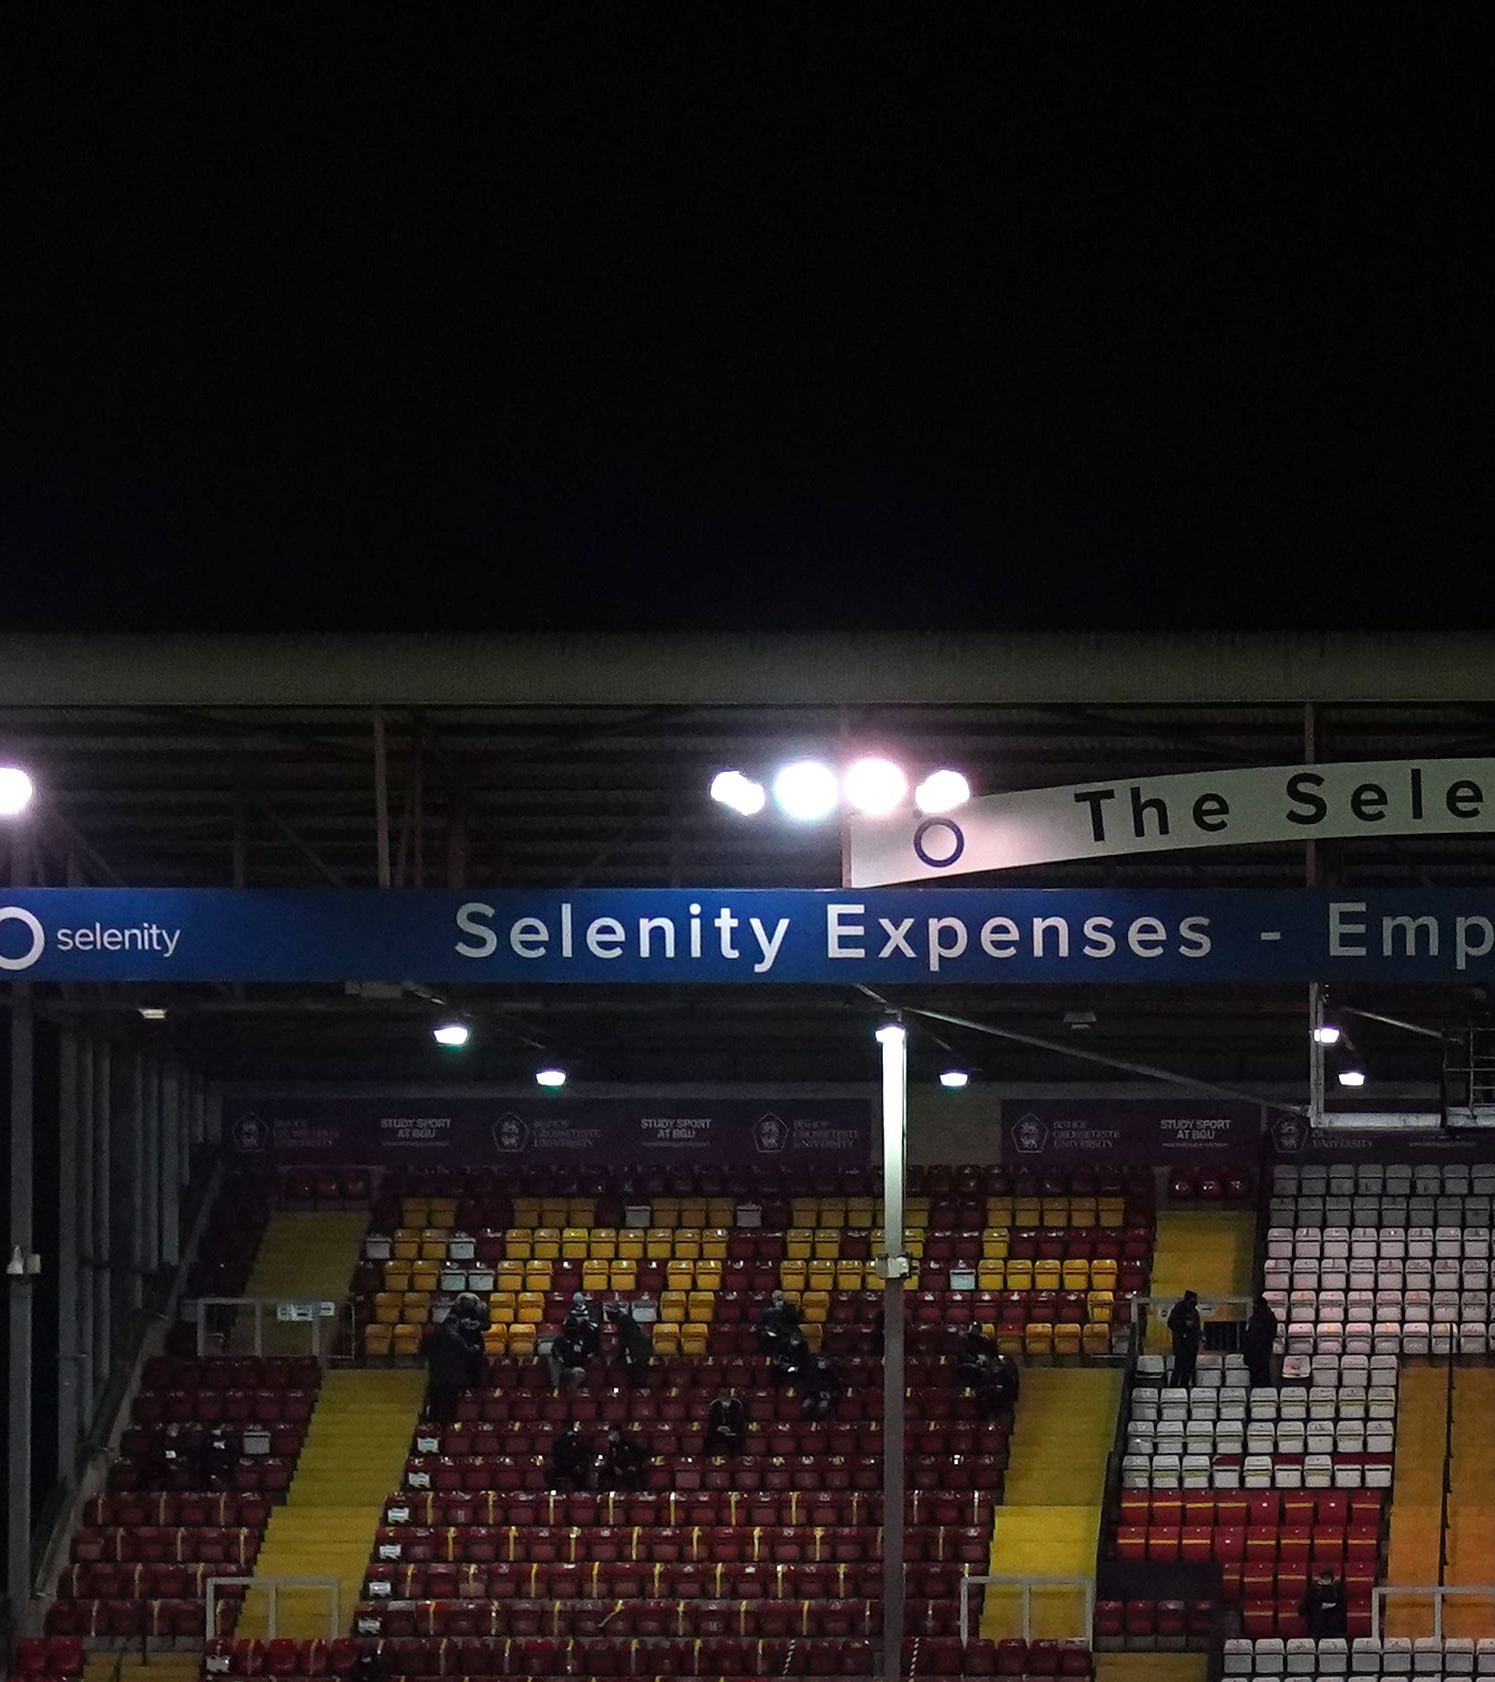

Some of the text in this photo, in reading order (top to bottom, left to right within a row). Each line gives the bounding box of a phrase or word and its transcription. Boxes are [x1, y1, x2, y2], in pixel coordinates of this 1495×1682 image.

[1074, 788, 1231, 843] The
[56, 921, 182, 958] selenity
[454, 902, 791, 974] Selenity
[827, 903, 1213, 972] Expenses
[1160, 1119, 1232, 1129] STUDY SPORT
[1176, 1129, 1191, 1139] AT
